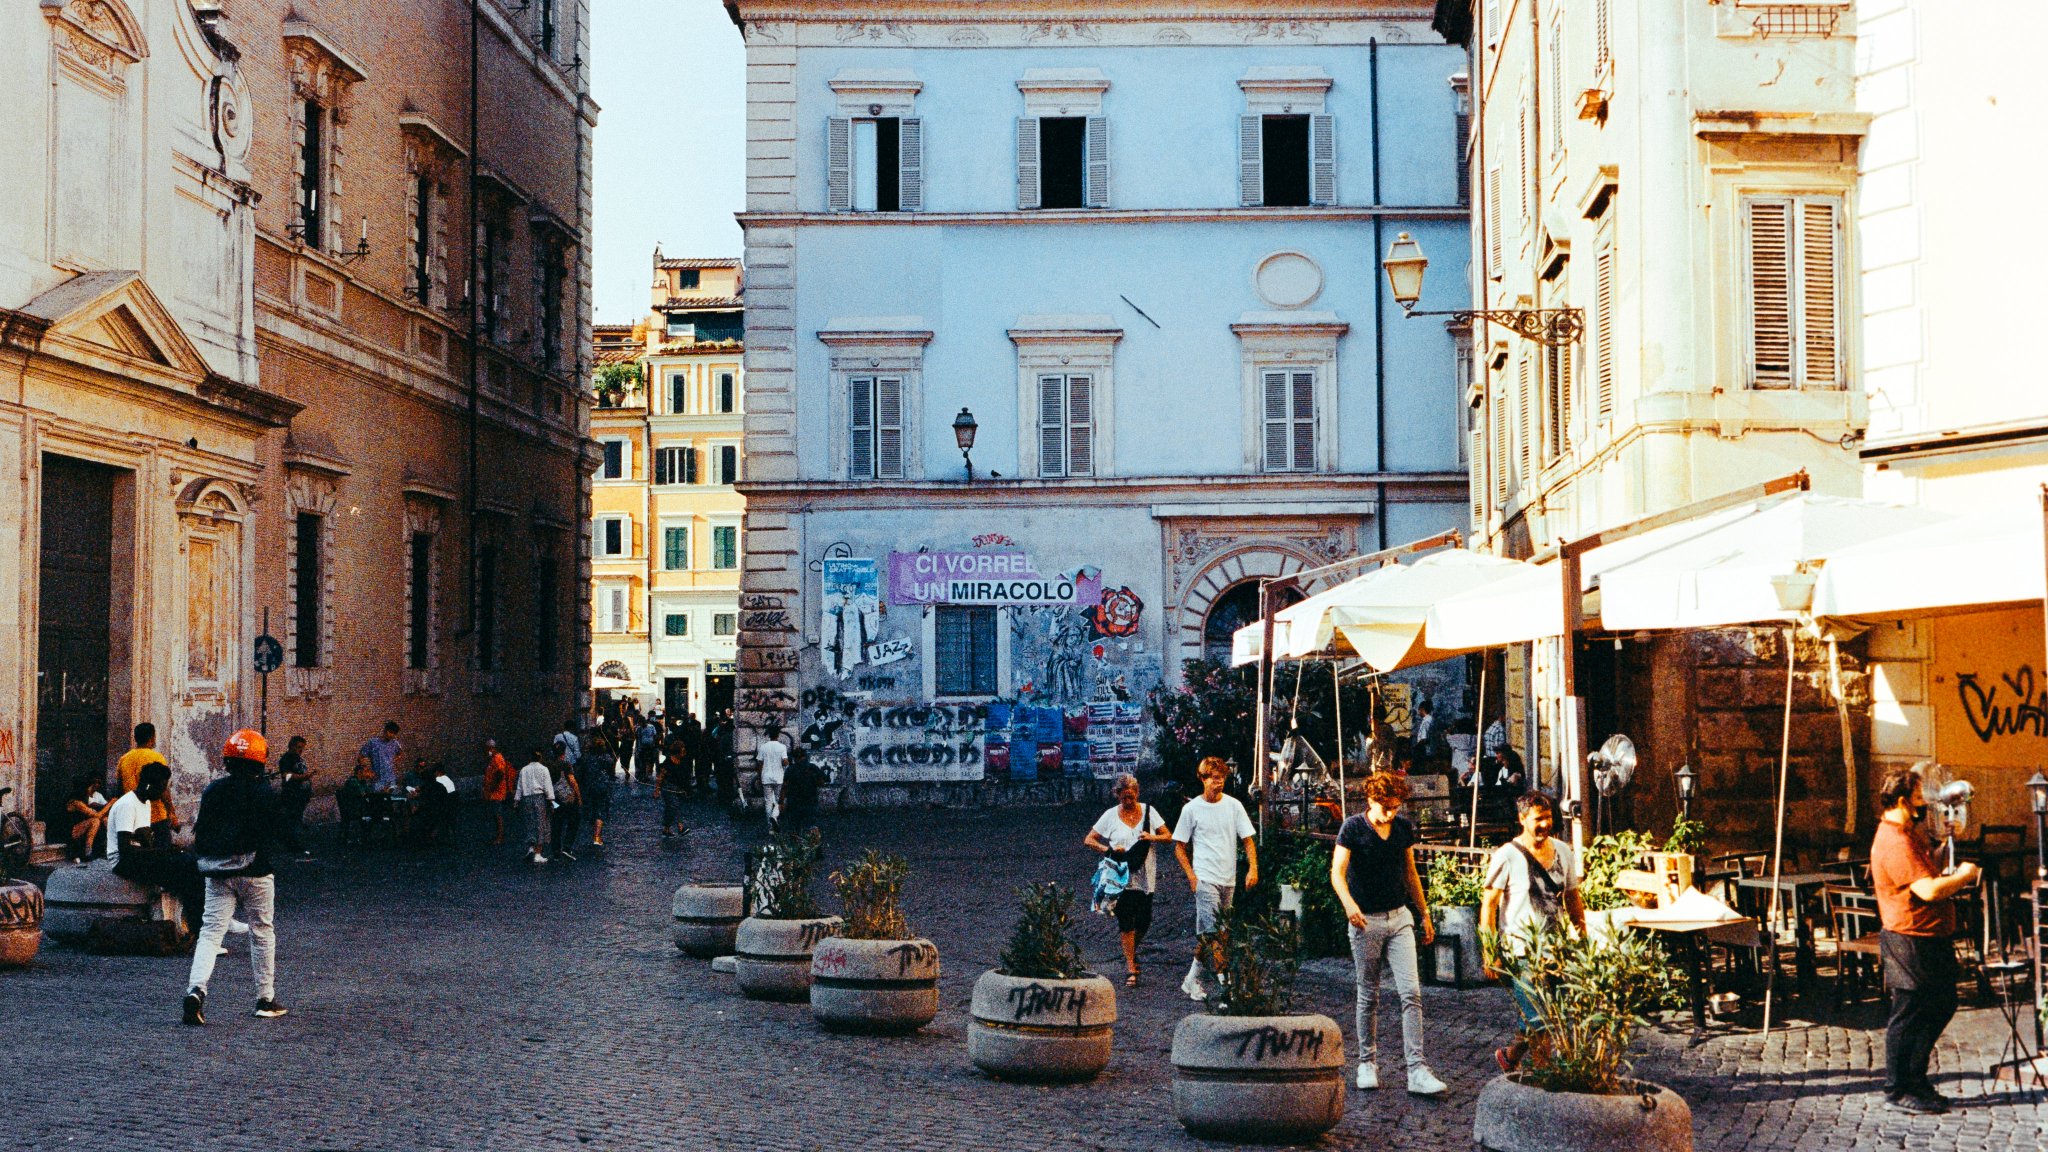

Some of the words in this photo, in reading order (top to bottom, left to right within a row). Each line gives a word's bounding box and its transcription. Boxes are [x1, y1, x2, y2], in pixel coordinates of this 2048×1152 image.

[915, 555, 938, 574] CI
[914, 582, 945, 600] UN
[952, 582, 1074, 600] MIRACOLO
[711, 663, 728, 672] Blue
[1007, 983, 1087, 1026] TRUTH
[1219, 1025, 1325, 1062] TRUTH
